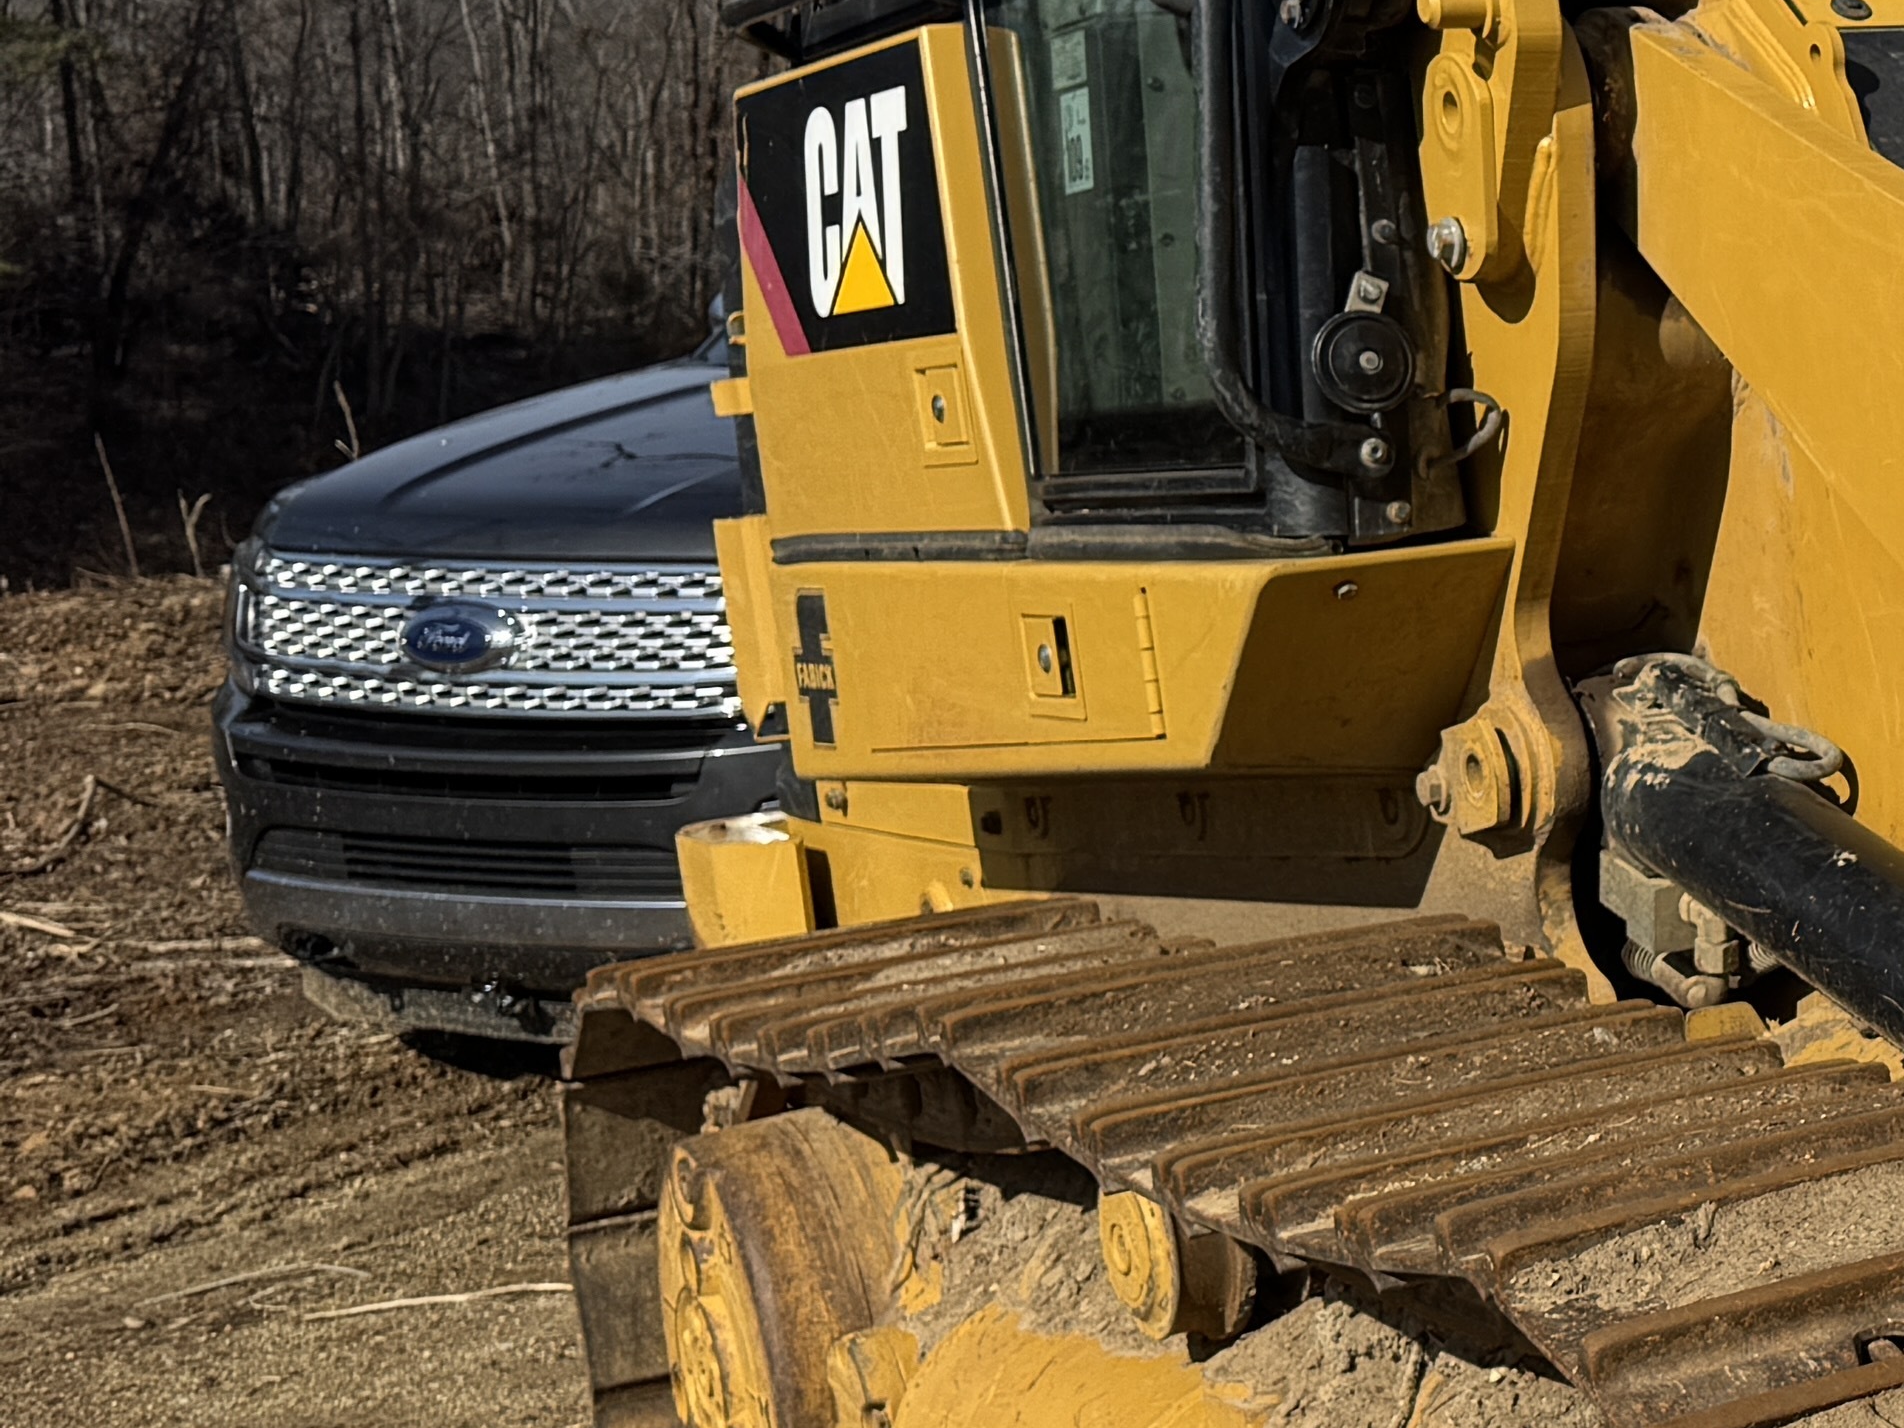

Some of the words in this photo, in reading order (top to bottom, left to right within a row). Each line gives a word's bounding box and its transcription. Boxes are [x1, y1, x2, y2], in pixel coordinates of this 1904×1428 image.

[804, 85, 907, 318] CAT
[417, 621, 471, 653] Ford
[796, 662, 836, 690] FABICK
